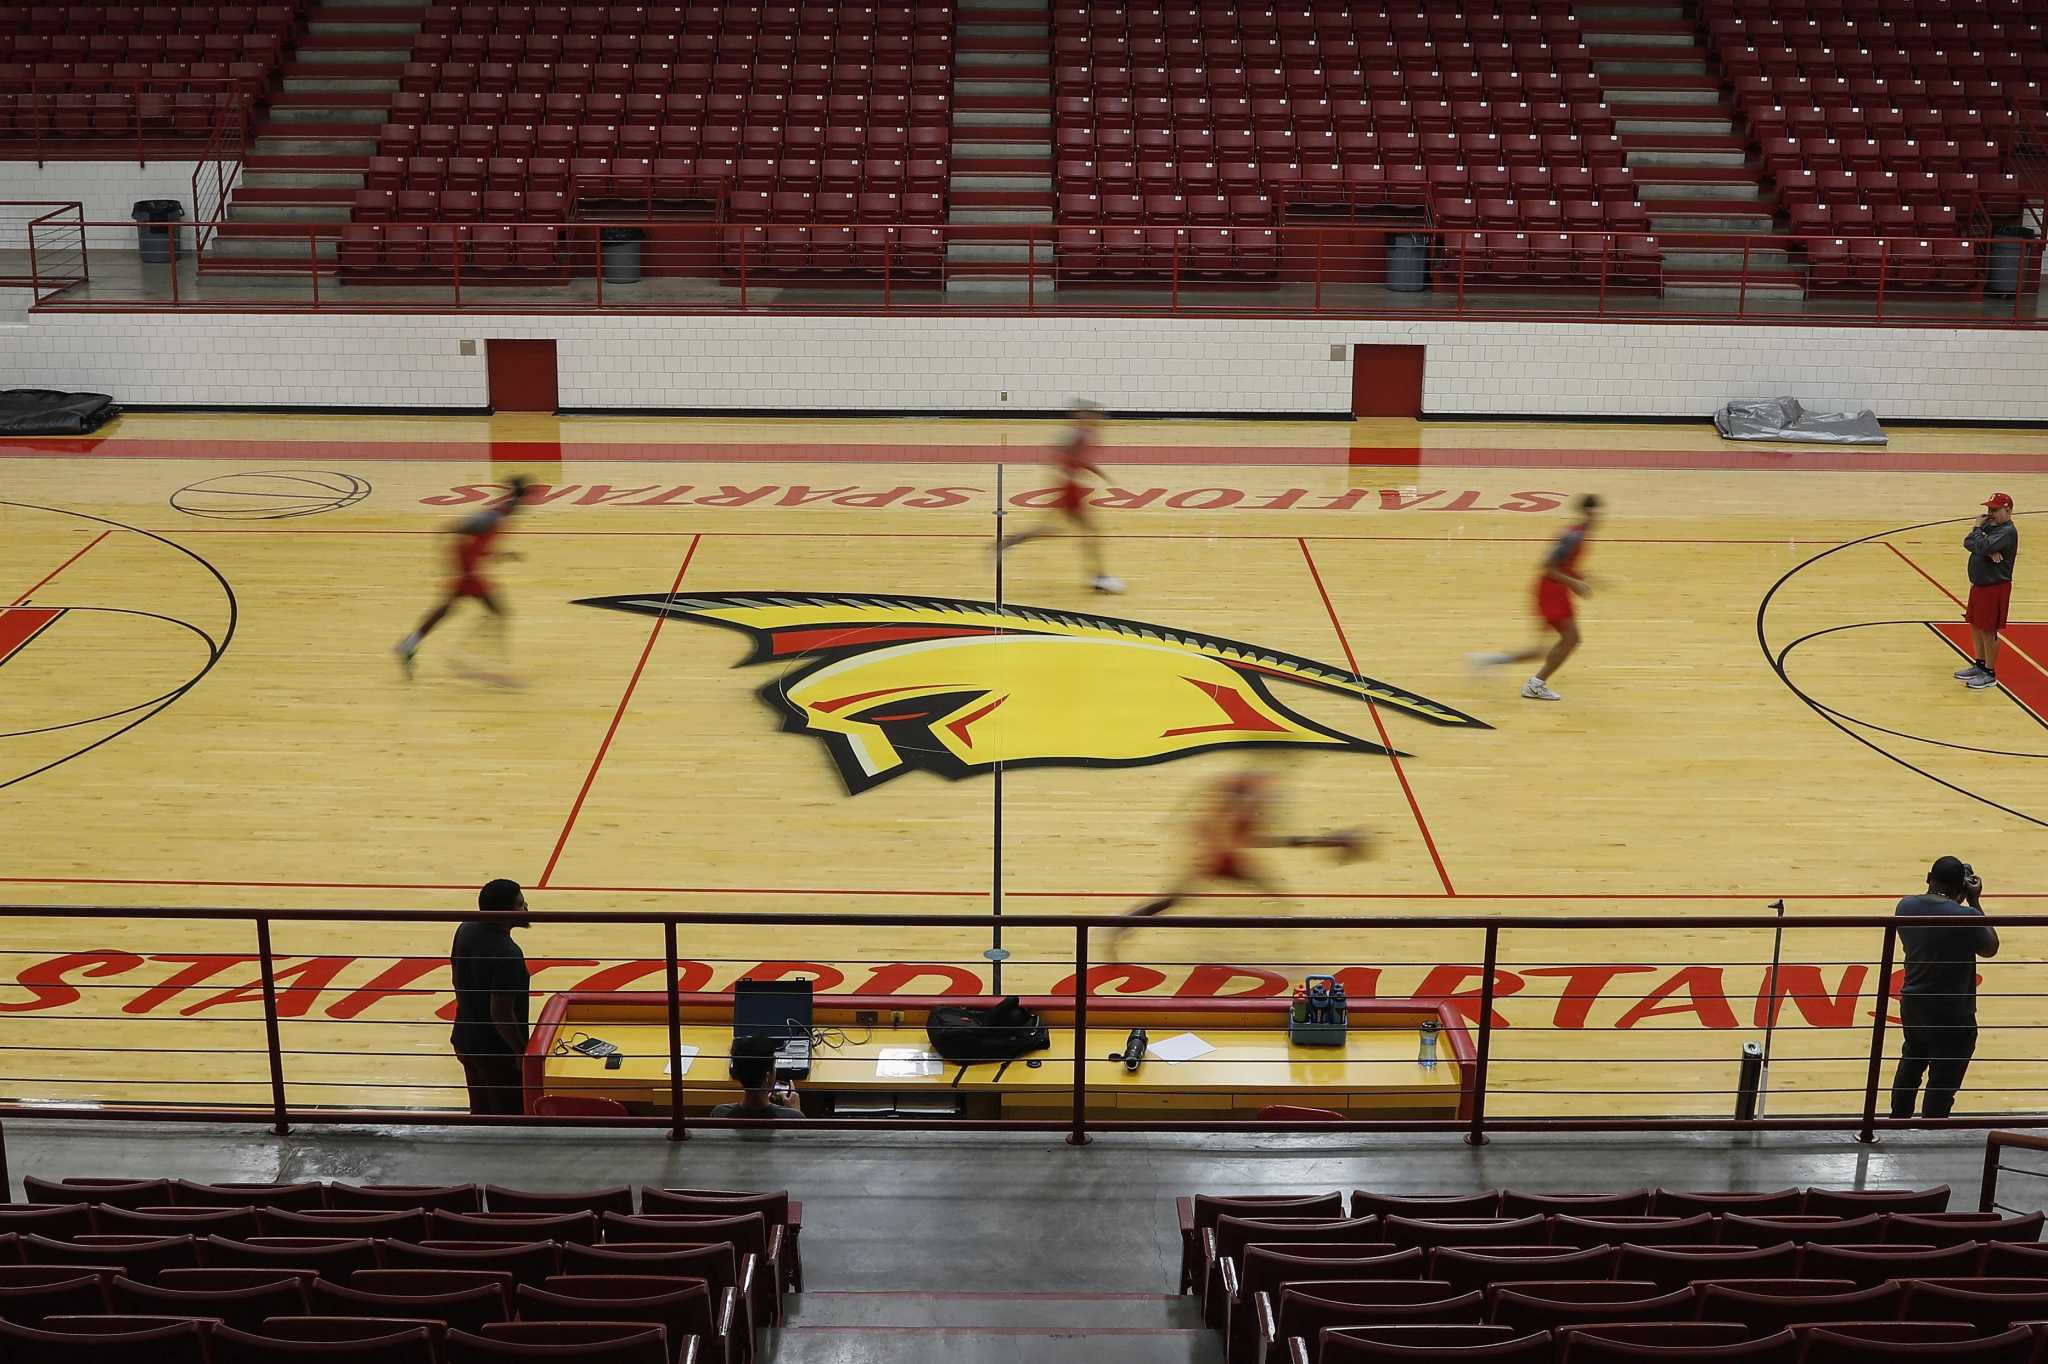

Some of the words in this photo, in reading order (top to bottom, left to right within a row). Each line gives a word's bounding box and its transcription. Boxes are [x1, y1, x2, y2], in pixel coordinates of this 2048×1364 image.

[419, 484, 985, 508] SPARTANS
[1008, 487, 1570, 512] STAFFORD
[0, 949, 983, 1020] STAFOD
[1050, 963, 1983, 1029] SPRTAN
